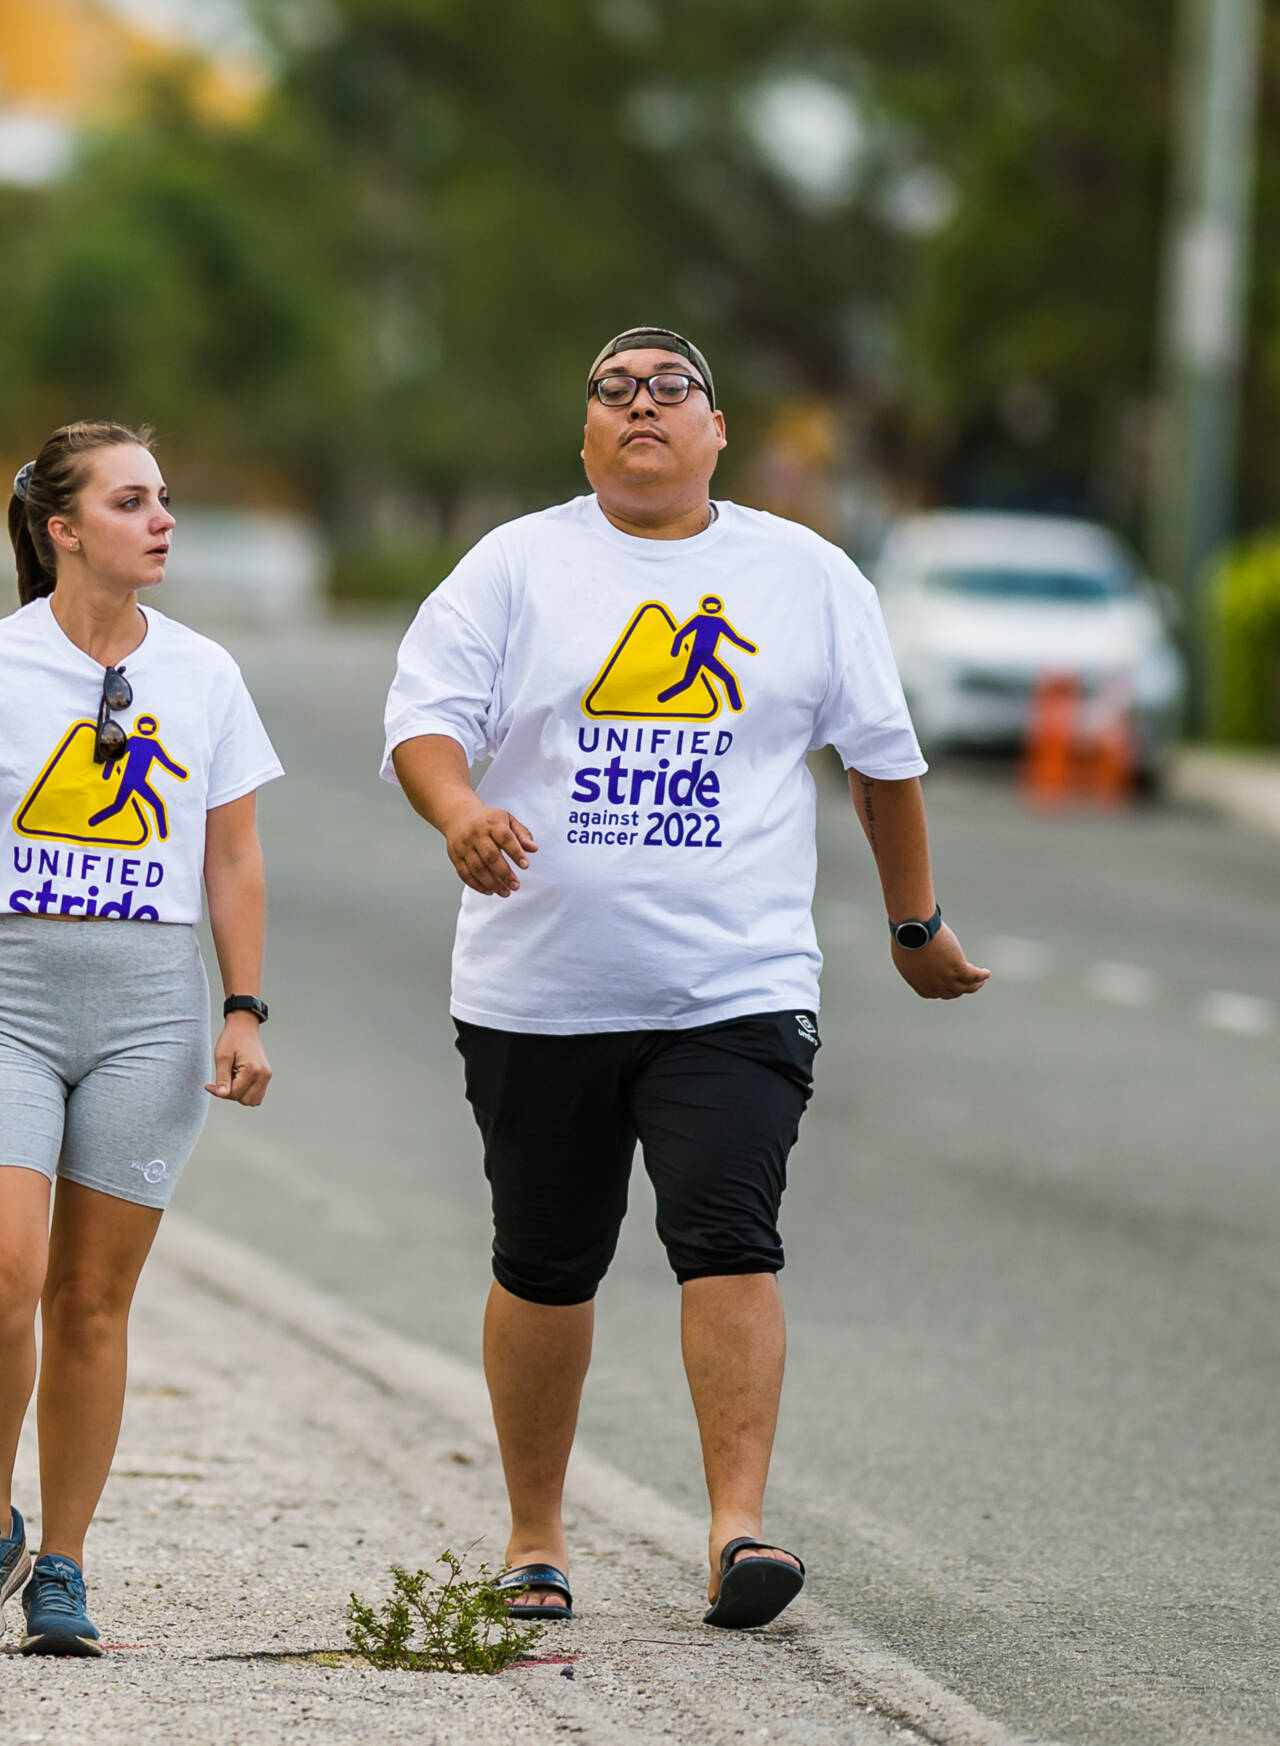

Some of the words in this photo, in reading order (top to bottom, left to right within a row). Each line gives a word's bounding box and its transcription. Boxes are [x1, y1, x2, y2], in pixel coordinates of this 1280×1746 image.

[578, 727, 733, 756] UNIFIED
[571, 755, 720, 808] stride
[569, 809, 639, 827] against
[643, 812, 722, 848] 2022
[567, 830, 638, 846] cancer
[13, 846, 164, 888] UNIFIED
